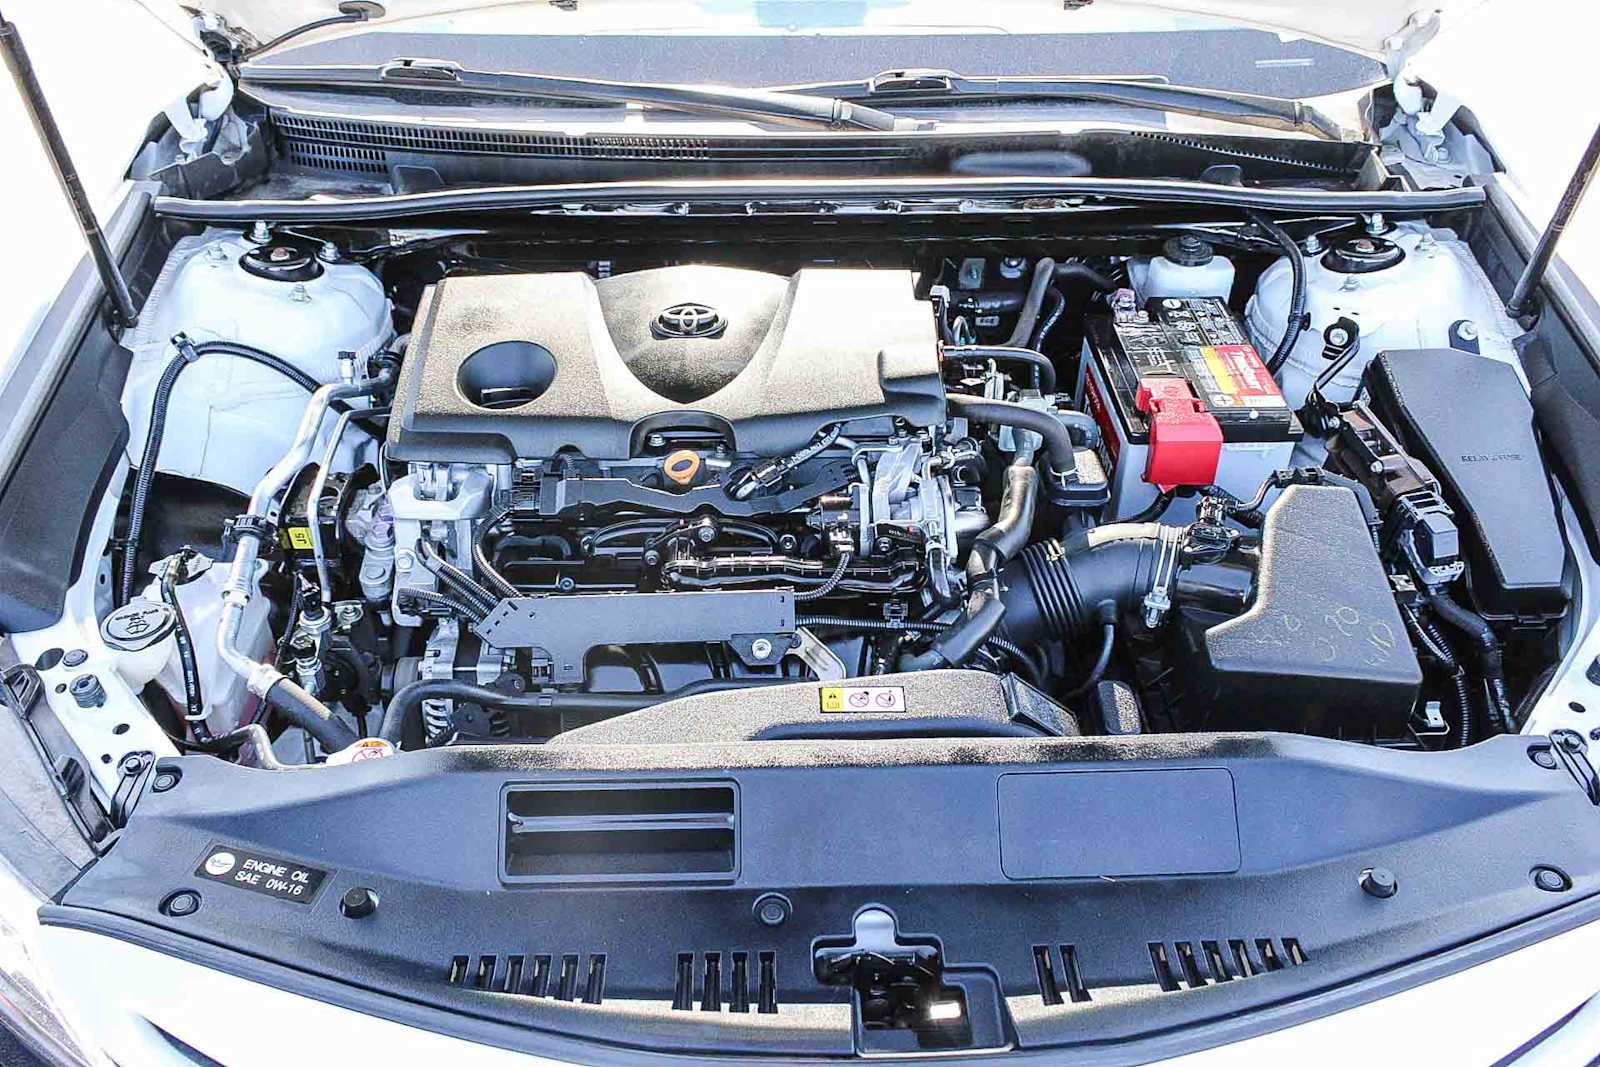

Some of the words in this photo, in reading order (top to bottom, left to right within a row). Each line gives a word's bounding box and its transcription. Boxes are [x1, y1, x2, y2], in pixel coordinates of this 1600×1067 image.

[234, 870, 262, 885] SAE
[265, 878, 304, 896] 0W-16
[242, 858, 288, 877] ENGINE
[291, 870, 310, 884] OIL
